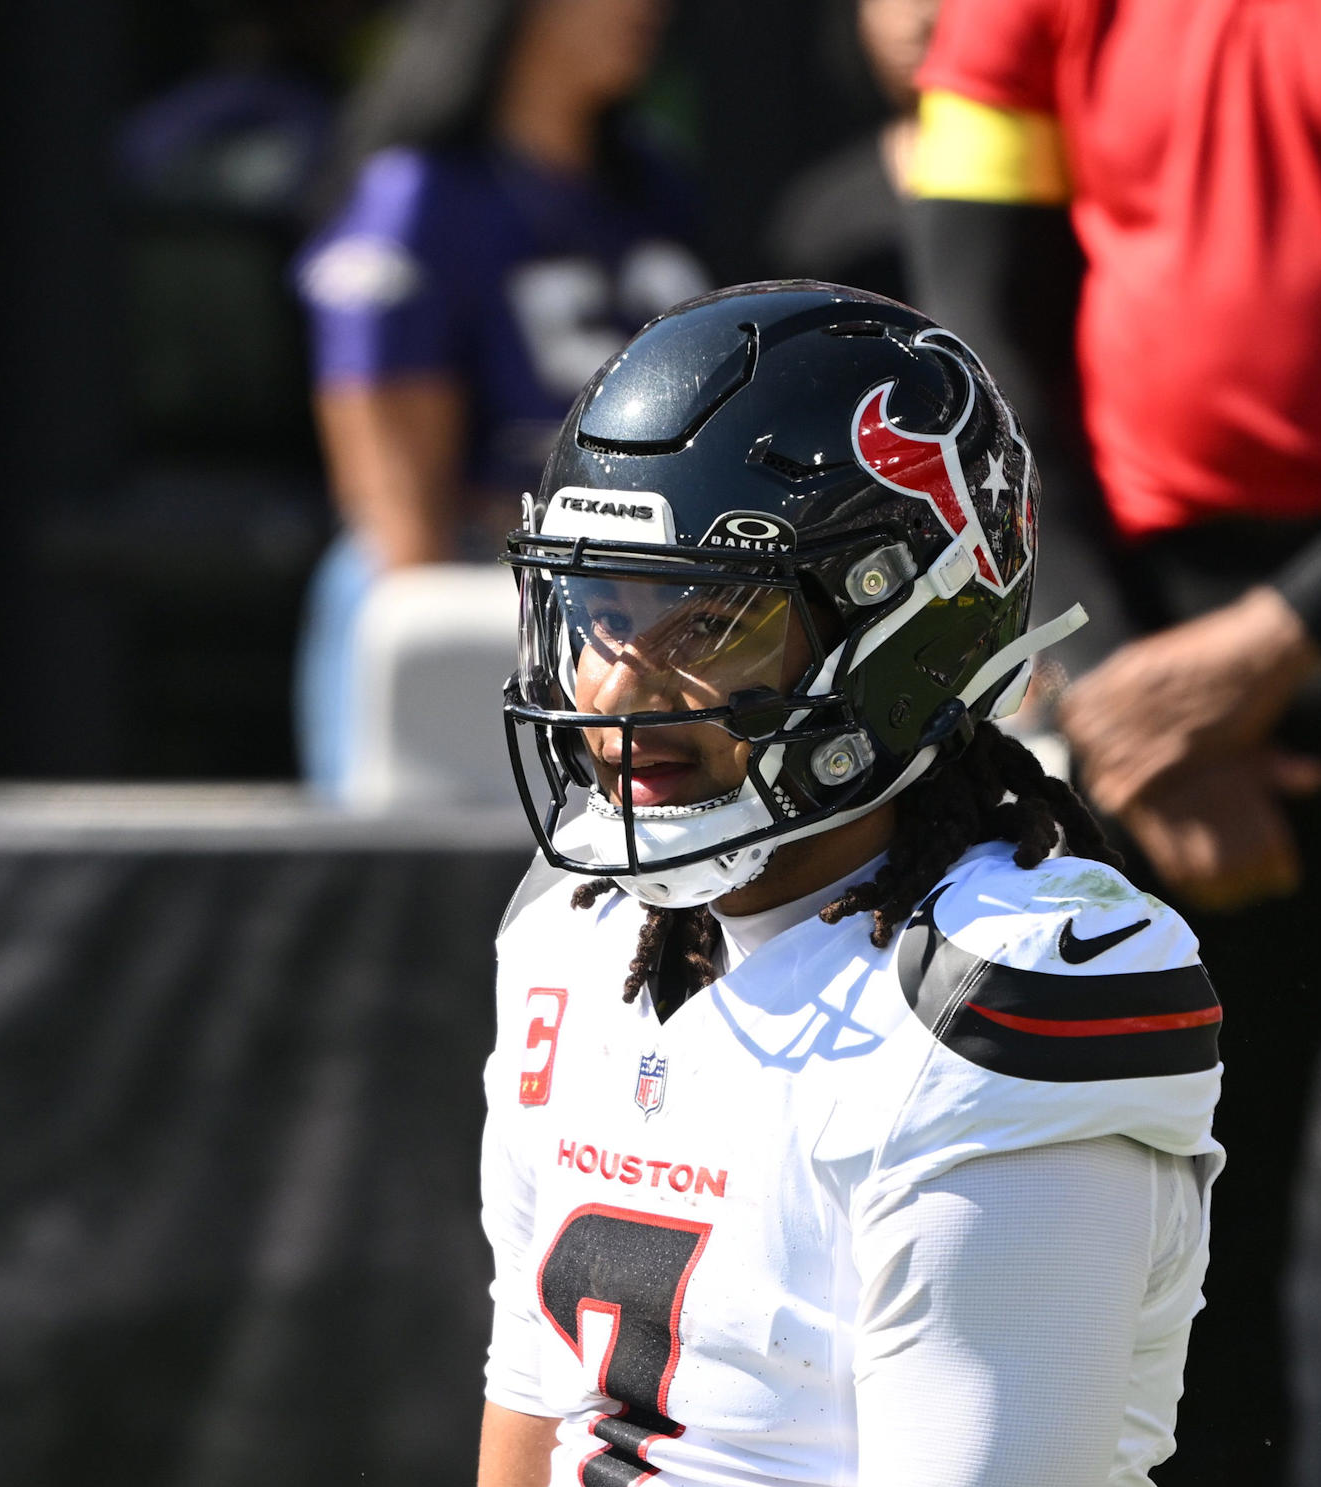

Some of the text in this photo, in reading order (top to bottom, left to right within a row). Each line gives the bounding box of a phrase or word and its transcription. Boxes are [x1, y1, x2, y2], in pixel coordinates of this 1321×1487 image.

[560, 496, 654, 520] TEXANS
[711, 535, 791, 553] OAKLEY
[637, 1077, 659, 1107] NFL
[558, 1138, 728, 1198] HOUSTON
